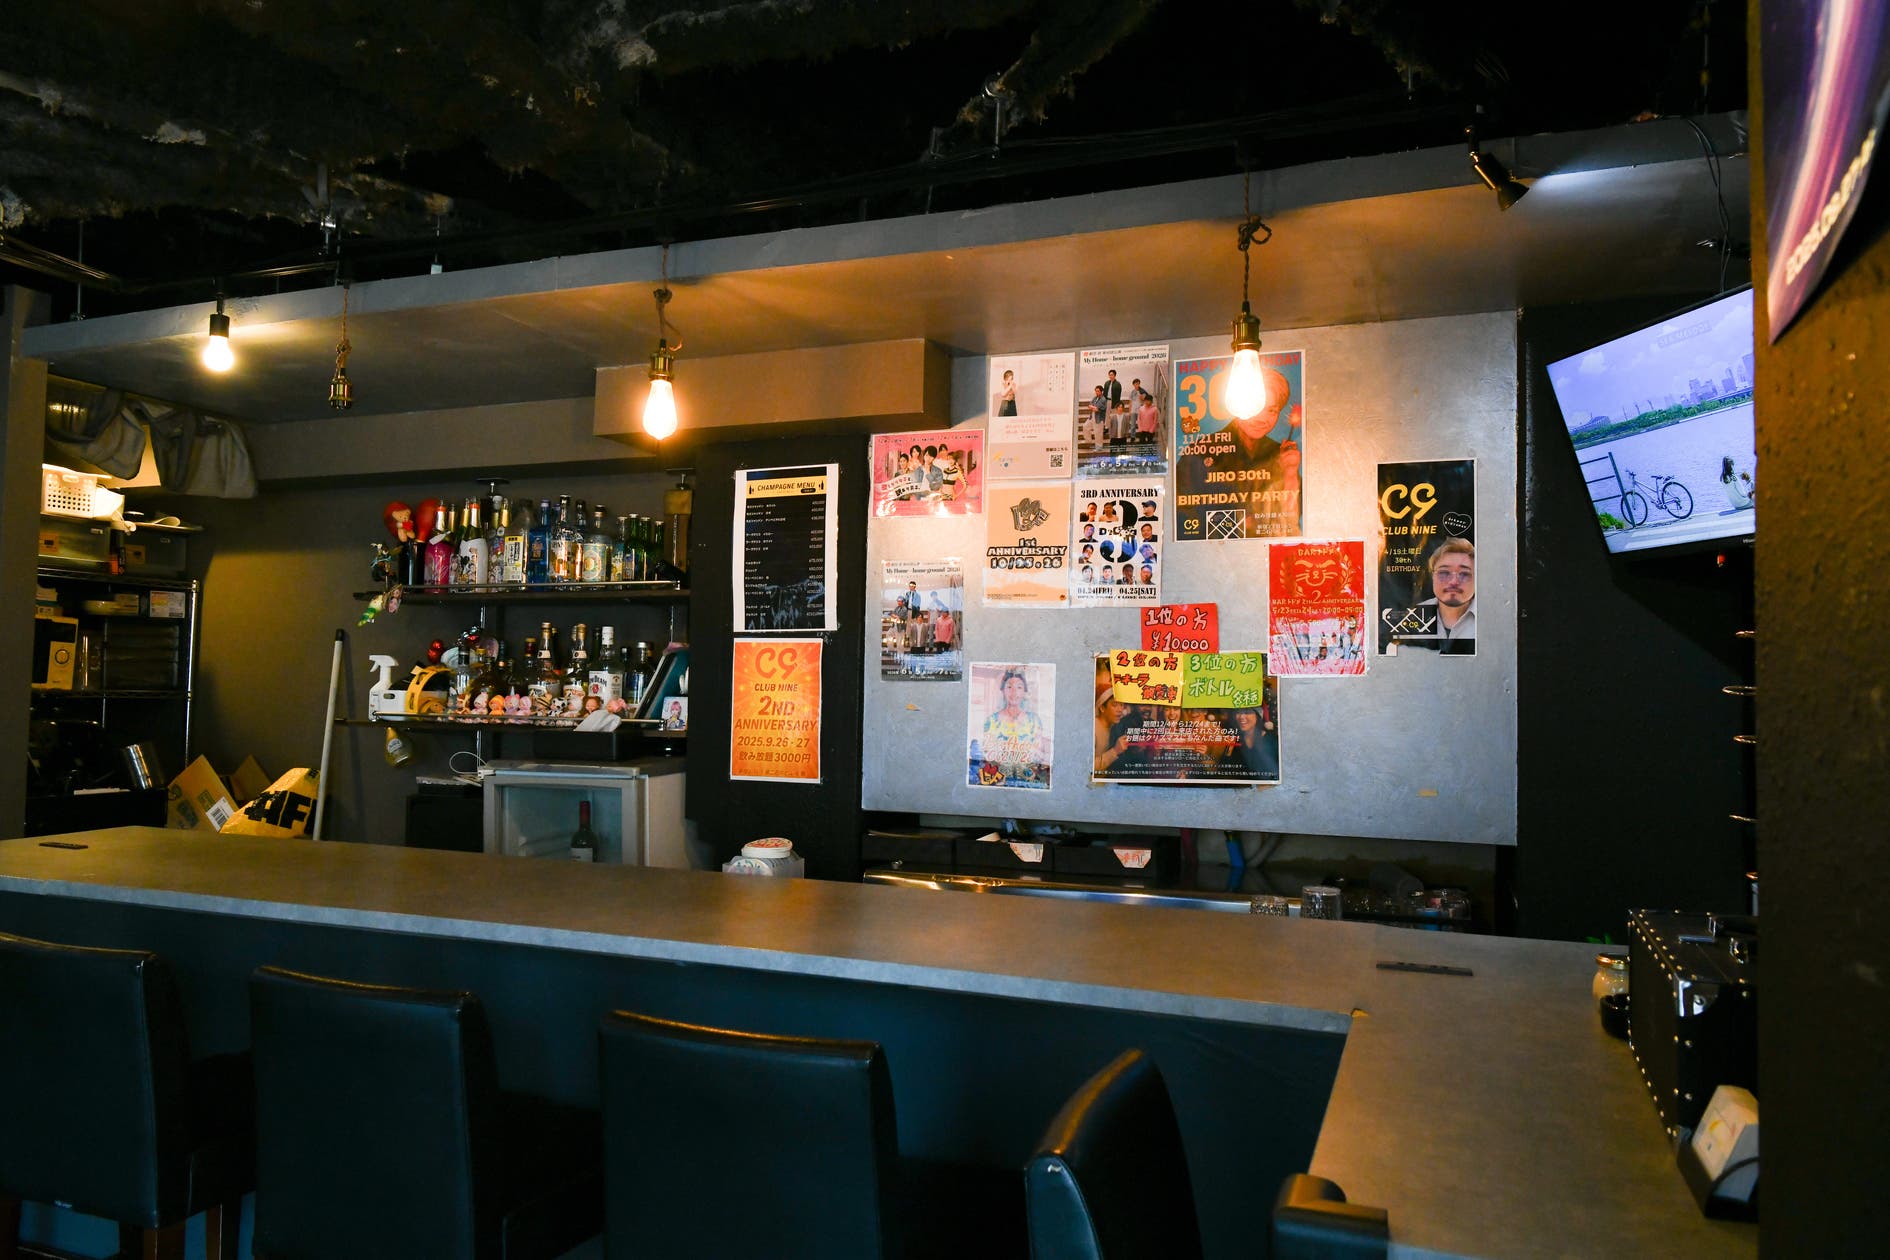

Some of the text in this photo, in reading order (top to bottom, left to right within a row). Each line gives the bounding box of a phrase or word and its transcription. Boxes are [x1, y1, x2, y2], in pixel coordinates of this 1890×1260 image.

[1179, 359, 1229, 374] HAPPY
[1182, 431, 1232, 446] 11/21 FRI
[1178, 444, 1236, 456] 20:00 open
[1205, 469, 1271, 483] JIRO 30th
[757, 481, 816, 492] CHAMPAGNE MENU
[1080, 488, 1159, 498] 3RD ANNIVERSARY
[1178, 490, 1300, 506] BIRTHDAY PARTY
[1382, 483, 1437, 520] C9
[1184, 519, 1200, 530] C9
[1383, 525, 1437, 537] CLUB NINE
[1019, 538, 1037, 547] 1st
[987, 546, 1067, 556] ANNIVERSARY
[1145, 606, 1208, 630] 1位の方
[755, 647, 798, 680] C9
[1117, 651, 1178, 670] 2位の方
[1190, 653, 1257, 674] 3位の方
[754, 683, 798, 692] CLUB NINE
[1188, 677, 1235, 697] ボトル
[758, 695, 795, 716] 2ND
[735, 719, 818, 732] ANNIVERSARY
